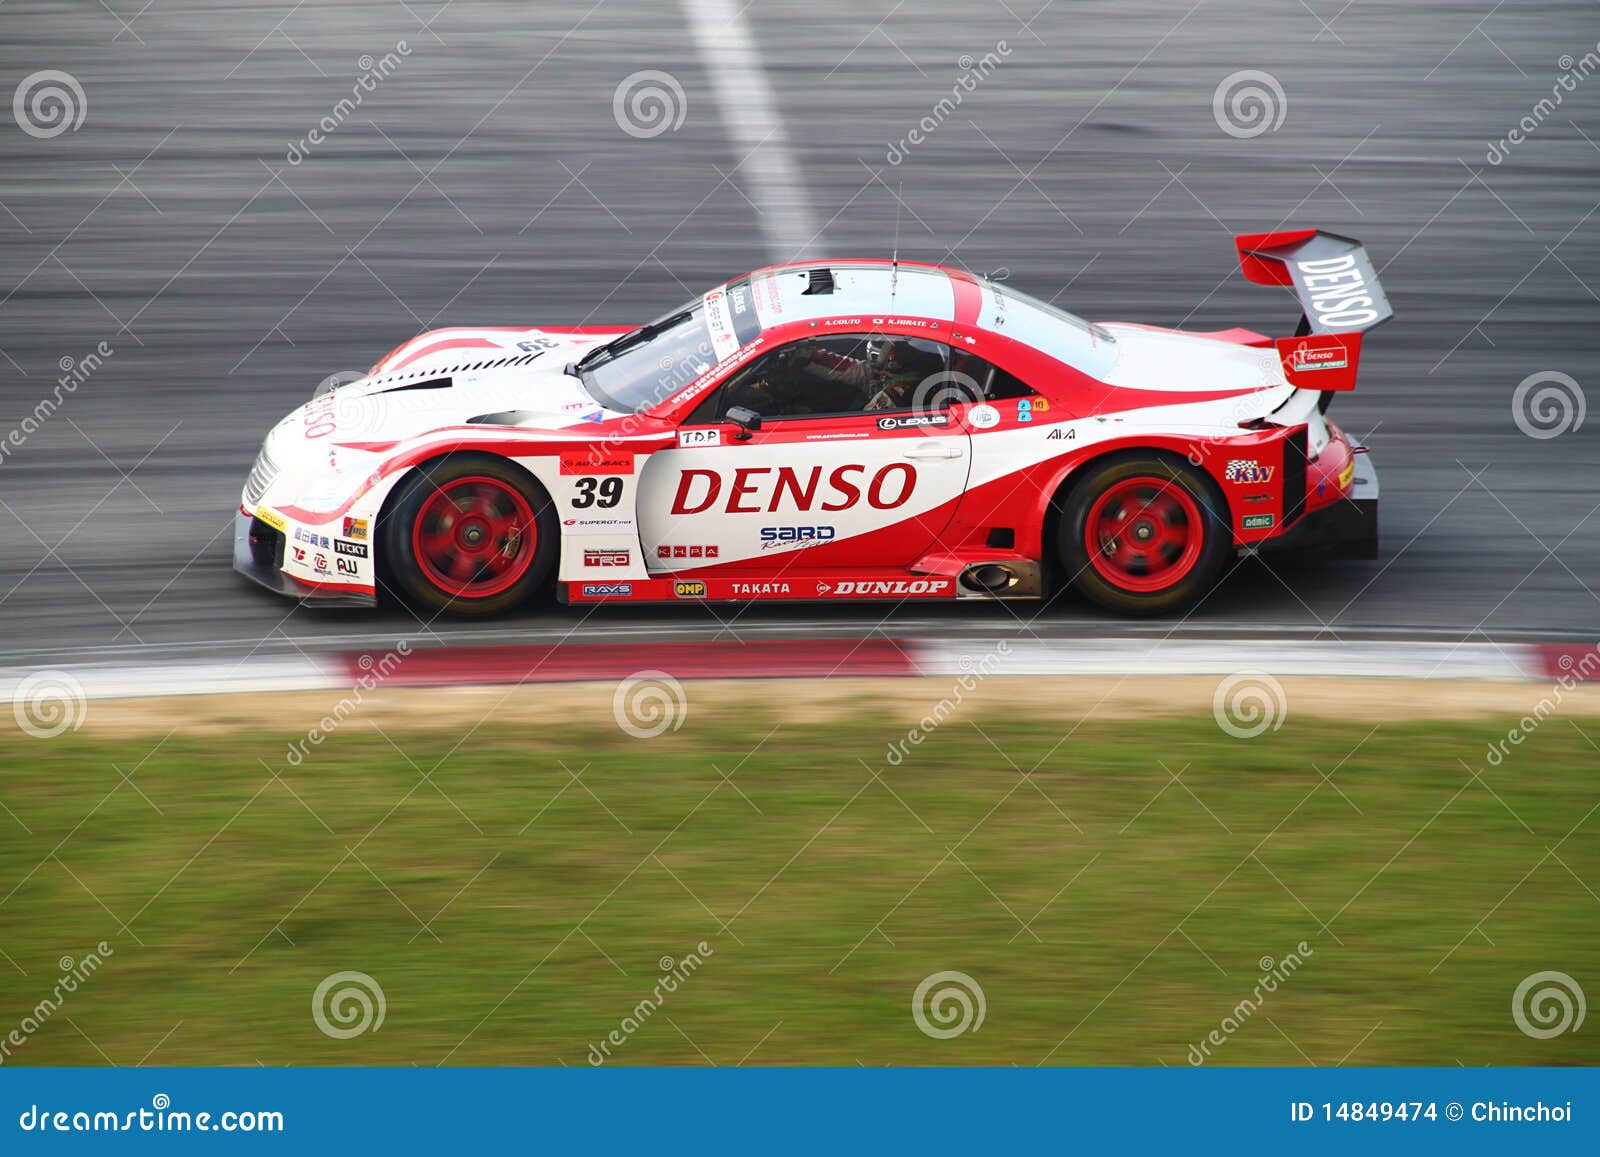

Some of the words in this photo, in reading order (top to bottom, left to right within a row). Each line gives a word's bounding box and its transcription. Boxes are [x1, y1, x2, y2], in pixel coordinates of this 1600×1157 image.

[1297, 255, 1378, 327] DENSO
[825, 318, 861, 326] A.COUTO
[897, 416, 947, 427] LEXUS
[571, 477, 624, 509] 39
[670, 462, 918, 515] DENSO
[586, 555, 629, 567] TRD
[584, 585, 631, 594] RAYS
[676, 583, 704, 595] OMP
[731, 583, 790, 593] TAKATA
[833, 580, 949, 595] DUNLOP
